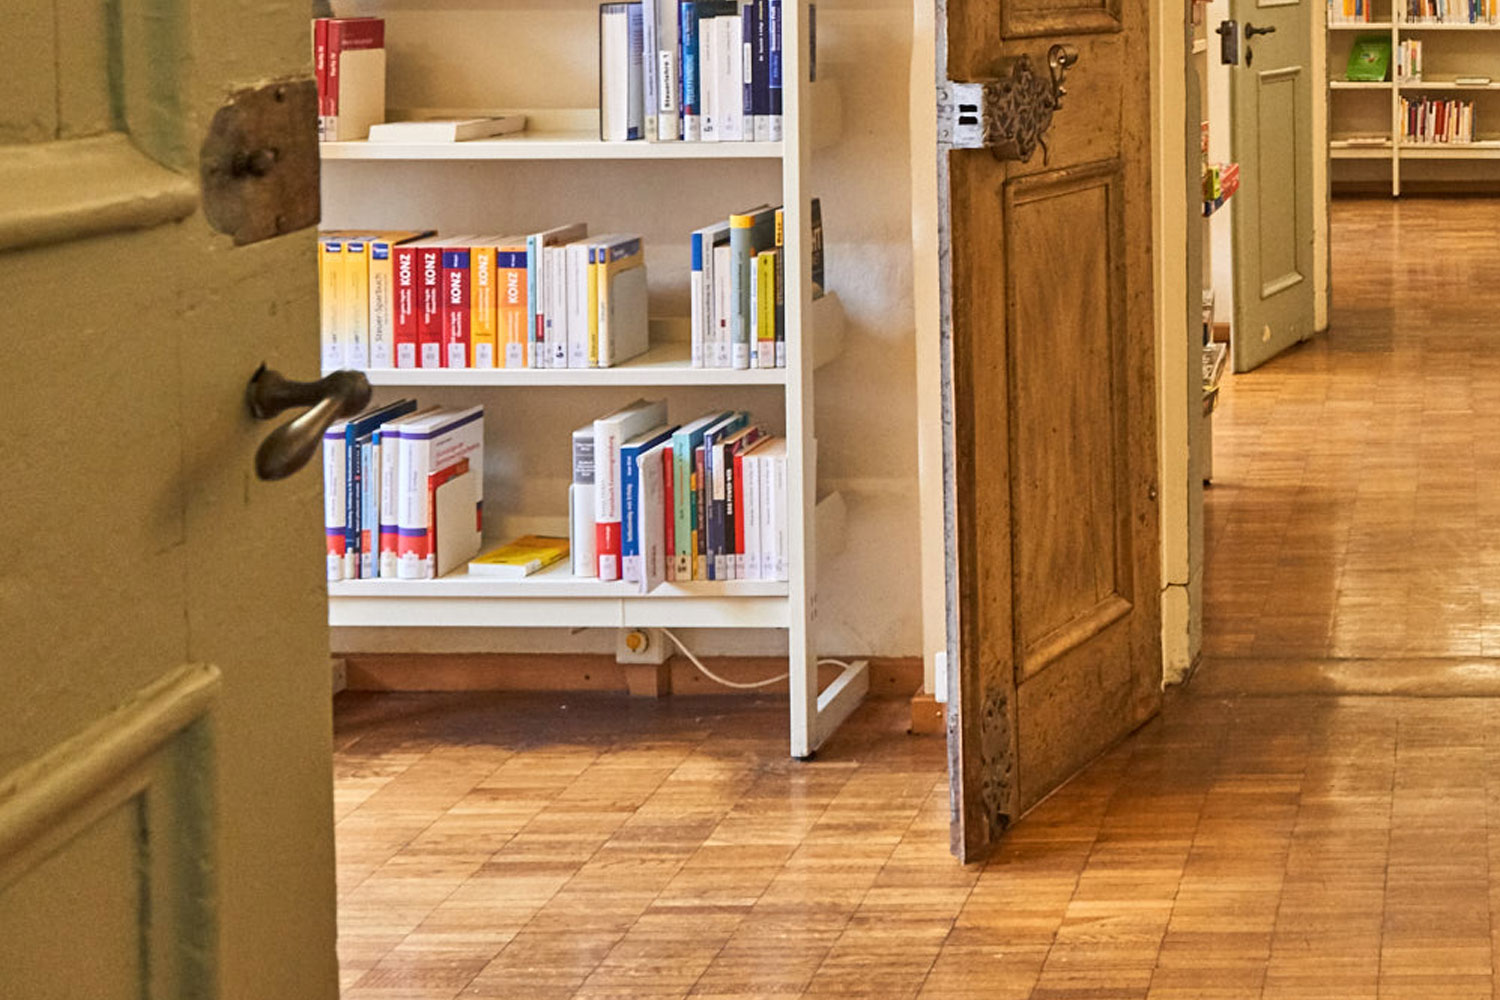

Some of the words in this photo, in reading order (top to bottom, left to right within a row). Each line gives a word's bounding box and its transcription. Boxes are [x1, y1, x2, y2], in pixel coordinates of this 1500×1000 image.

[400, 254, 411, 286] KONZ
[425, 253, 435, 286] KONZ
[478, 255, 488, 285] KONZ
[451, 272, 461, 304] KONZ
[507, 272, 518, 304] KONZ
